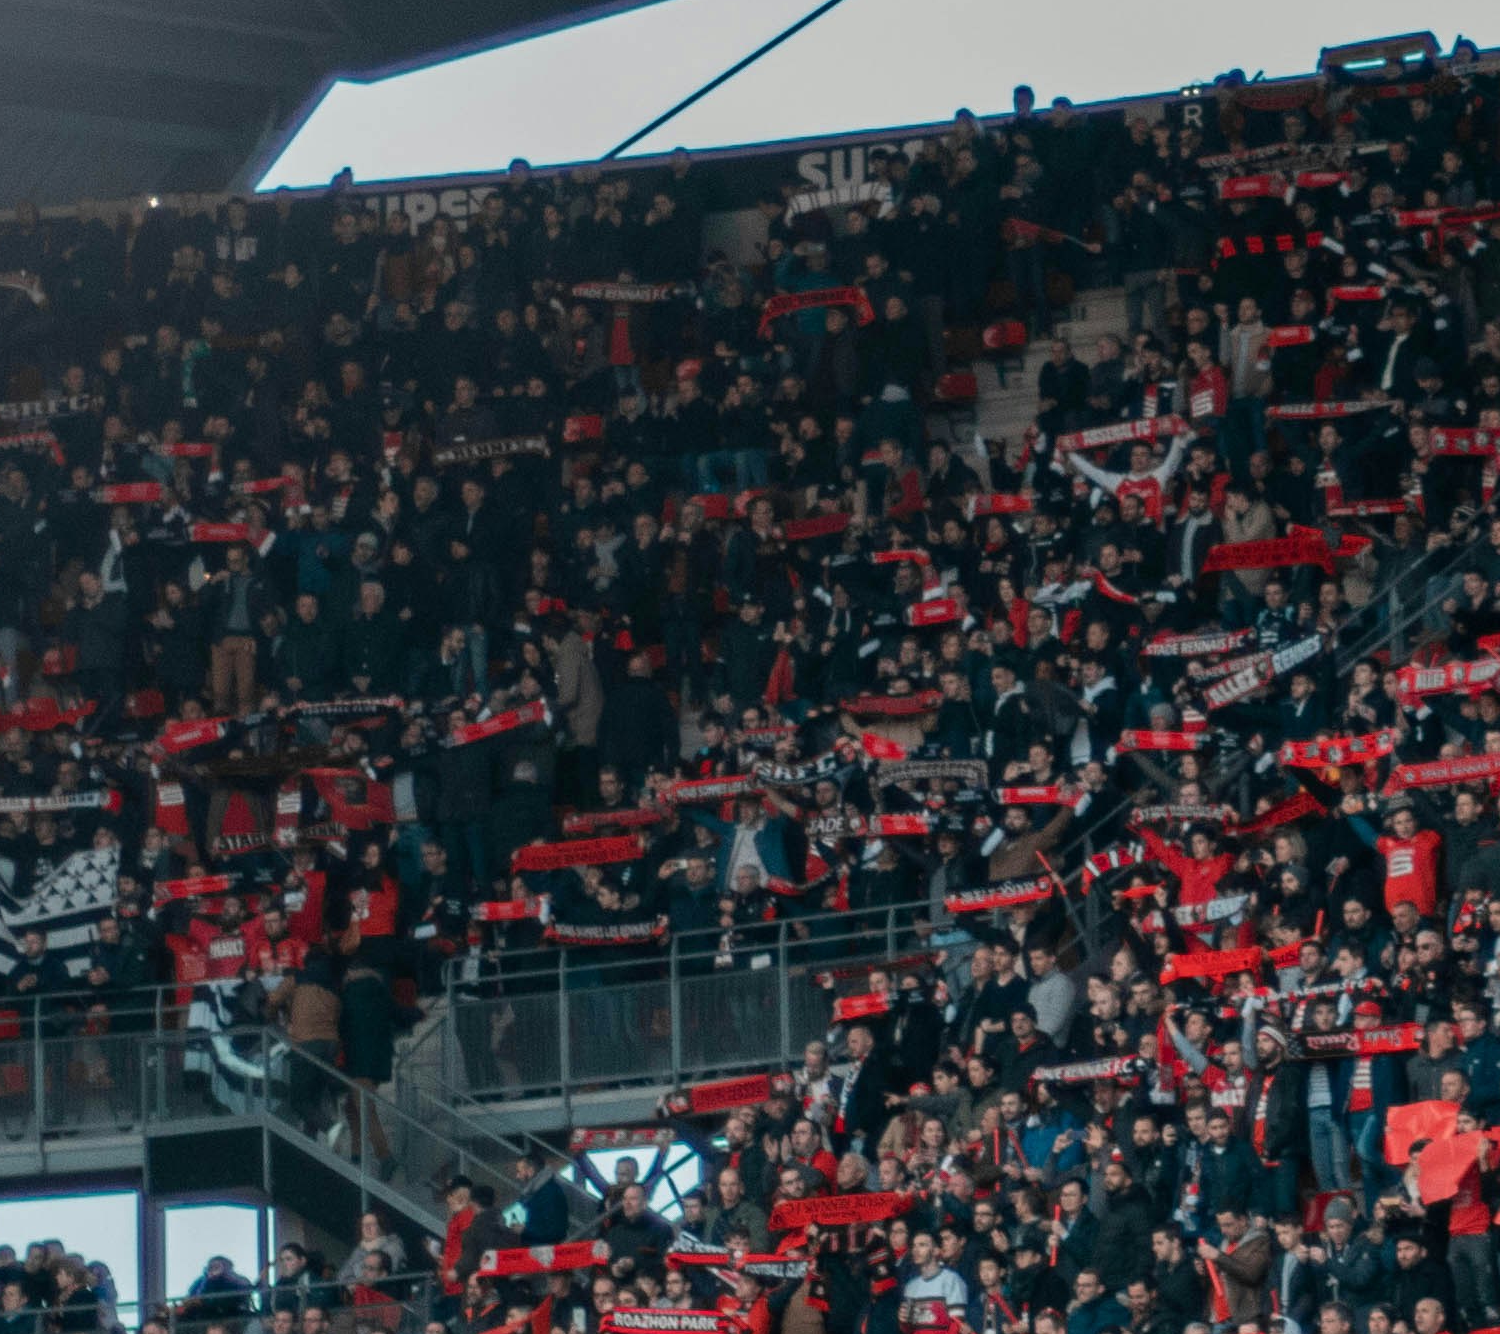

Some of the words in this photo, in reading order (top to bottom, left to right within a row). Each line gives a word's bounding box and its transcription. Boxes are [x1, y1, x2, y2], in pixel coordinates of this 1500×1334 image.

[1206, 671, 1260, 709] ALLEZ
[613, 1312, 676, 1332] ROAZHON
[678, 1314, 720, 1333] PARK
